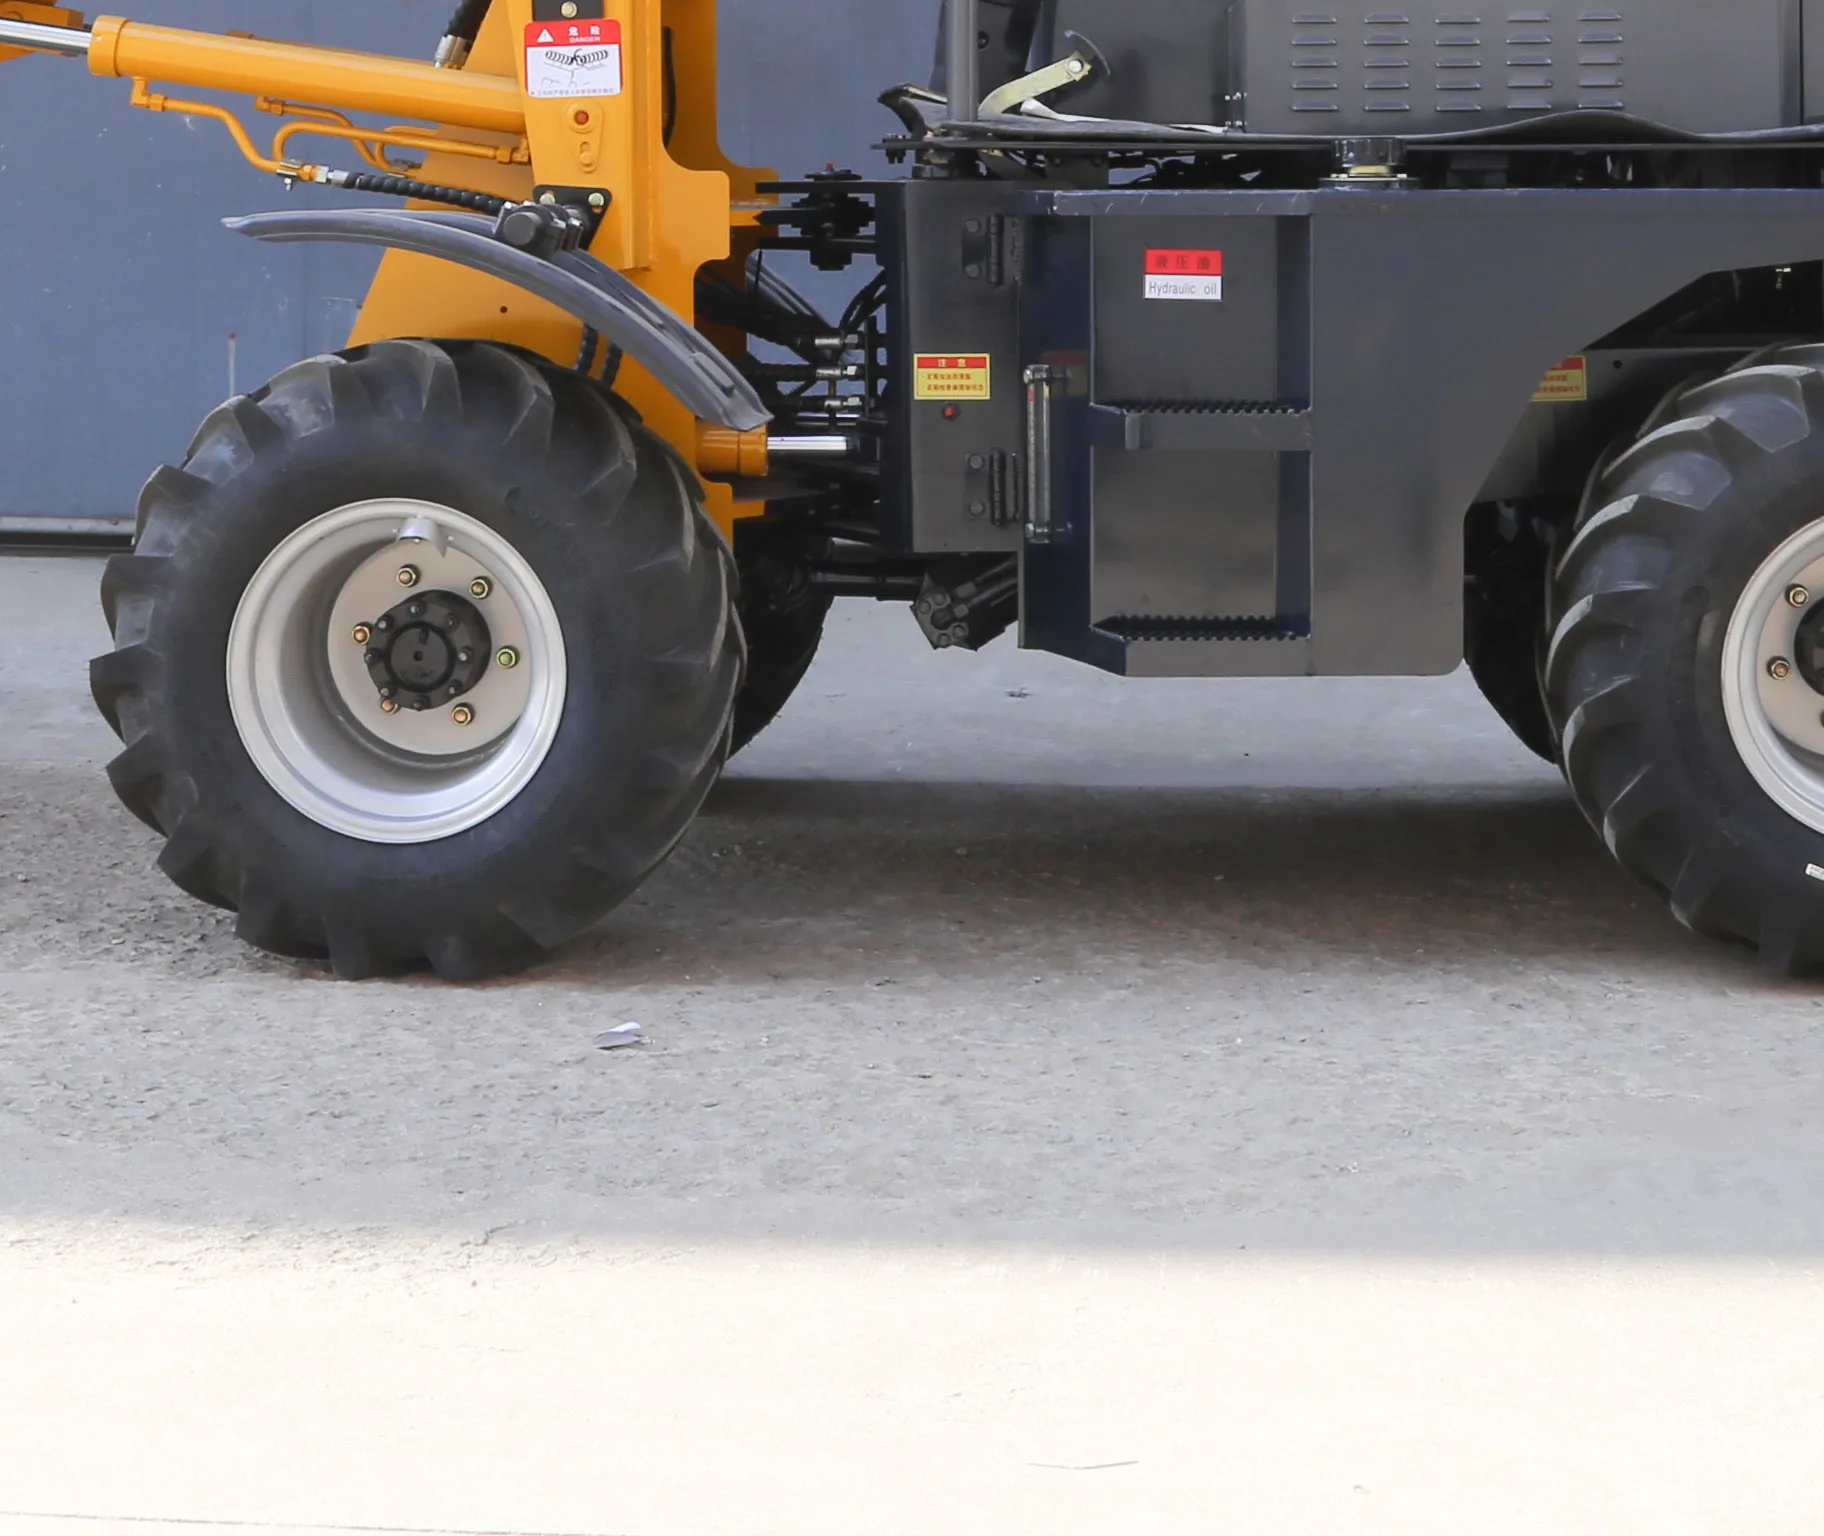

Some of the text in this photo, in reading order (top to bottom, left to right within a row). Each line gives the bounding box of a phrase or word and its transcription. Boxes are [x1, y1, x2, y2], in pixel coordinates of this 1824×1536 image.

[569, 36, 601, 44] DANGER
[1149, 281, 1217, 296] Hydraulic oil
